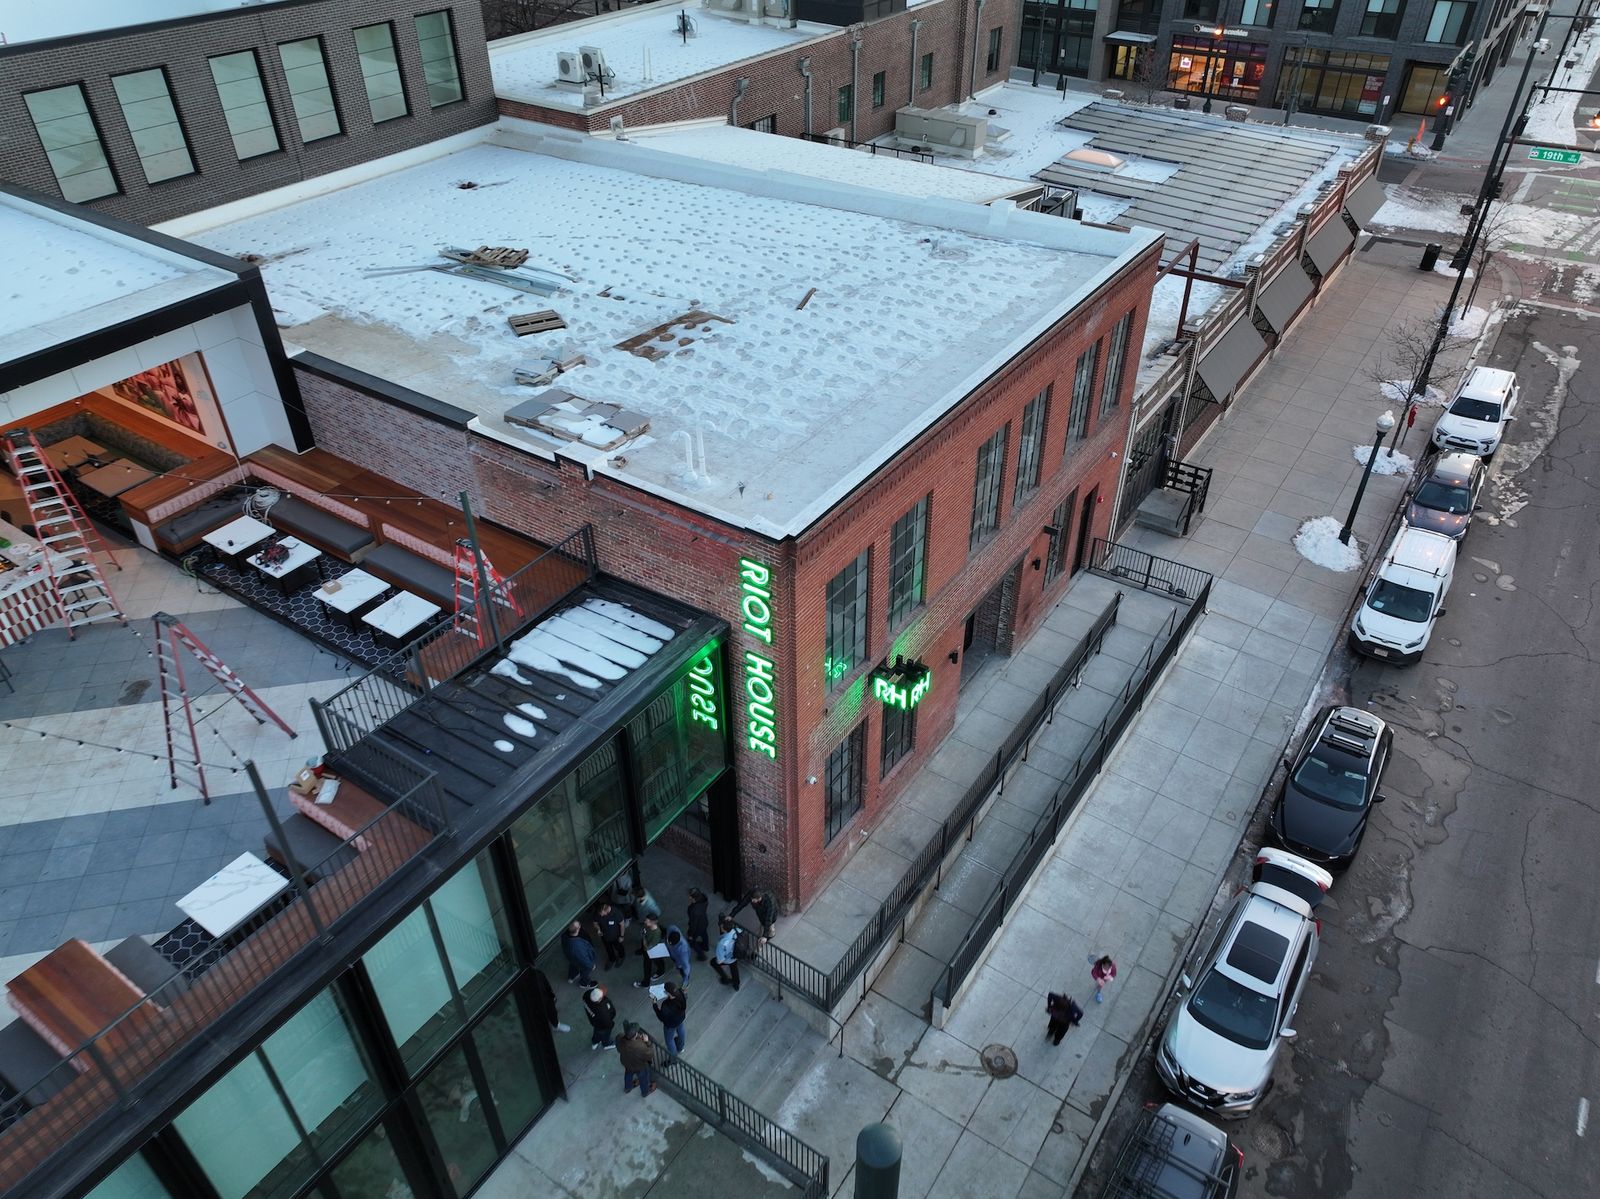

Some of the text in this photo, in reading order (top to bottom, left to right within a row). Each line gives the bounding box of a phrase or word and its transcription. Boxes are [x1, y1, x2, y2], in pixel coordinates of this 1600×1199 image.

[1542, 151, 1564, 161] 19th
[740, 557, 776, 760] RIOT HOUSE
[874, 677, 907, 710] RH
